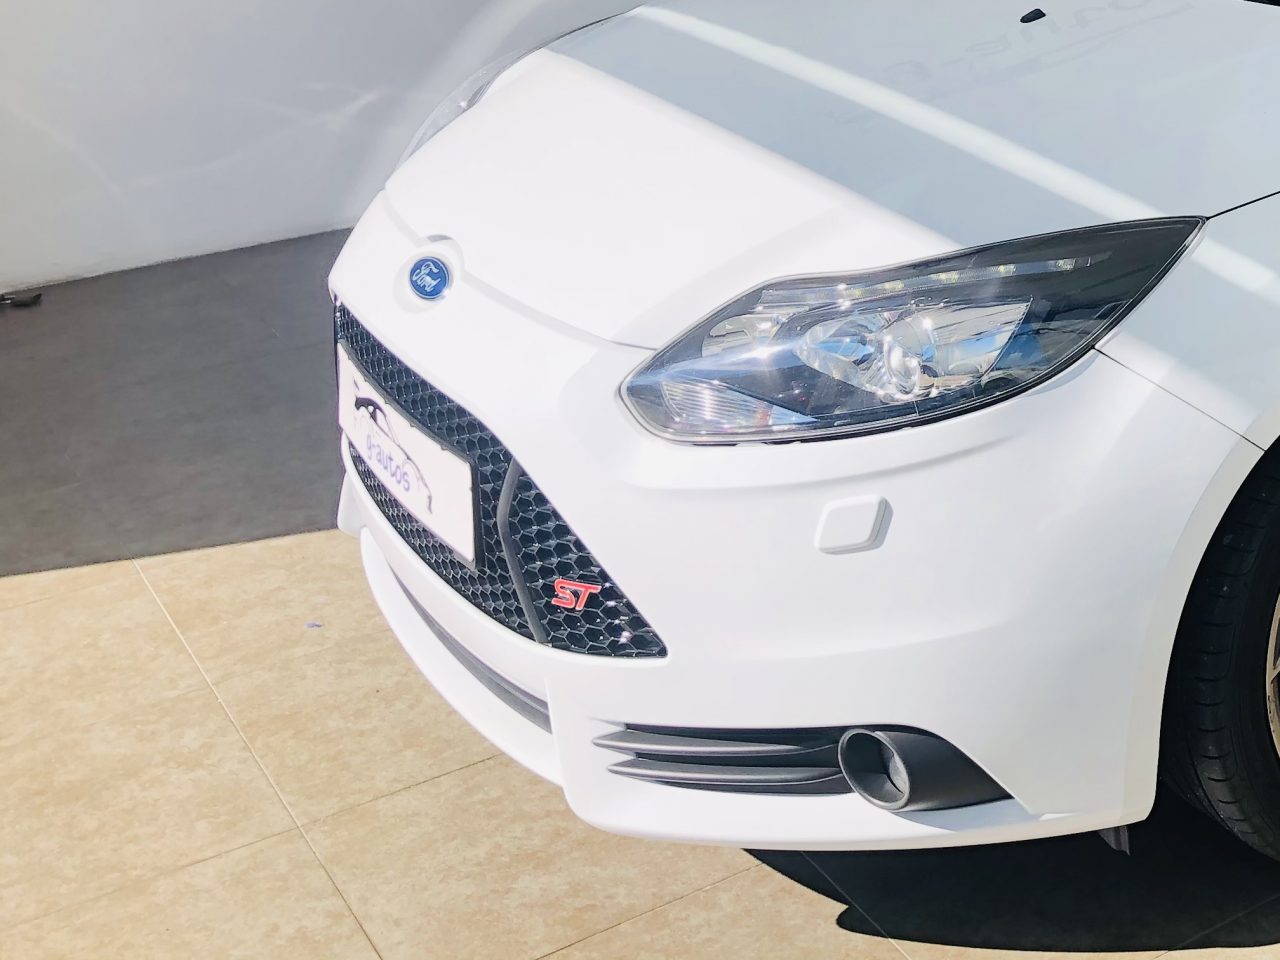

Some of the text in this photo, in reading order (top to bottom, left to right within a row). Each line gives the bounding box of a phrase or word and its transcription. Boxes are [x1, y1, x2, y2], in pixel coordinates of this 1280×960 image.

[412, 261, 441, 293] Ford
[366, 432, 411, 493] g-autos
[551, 578, 602, 610] ST
